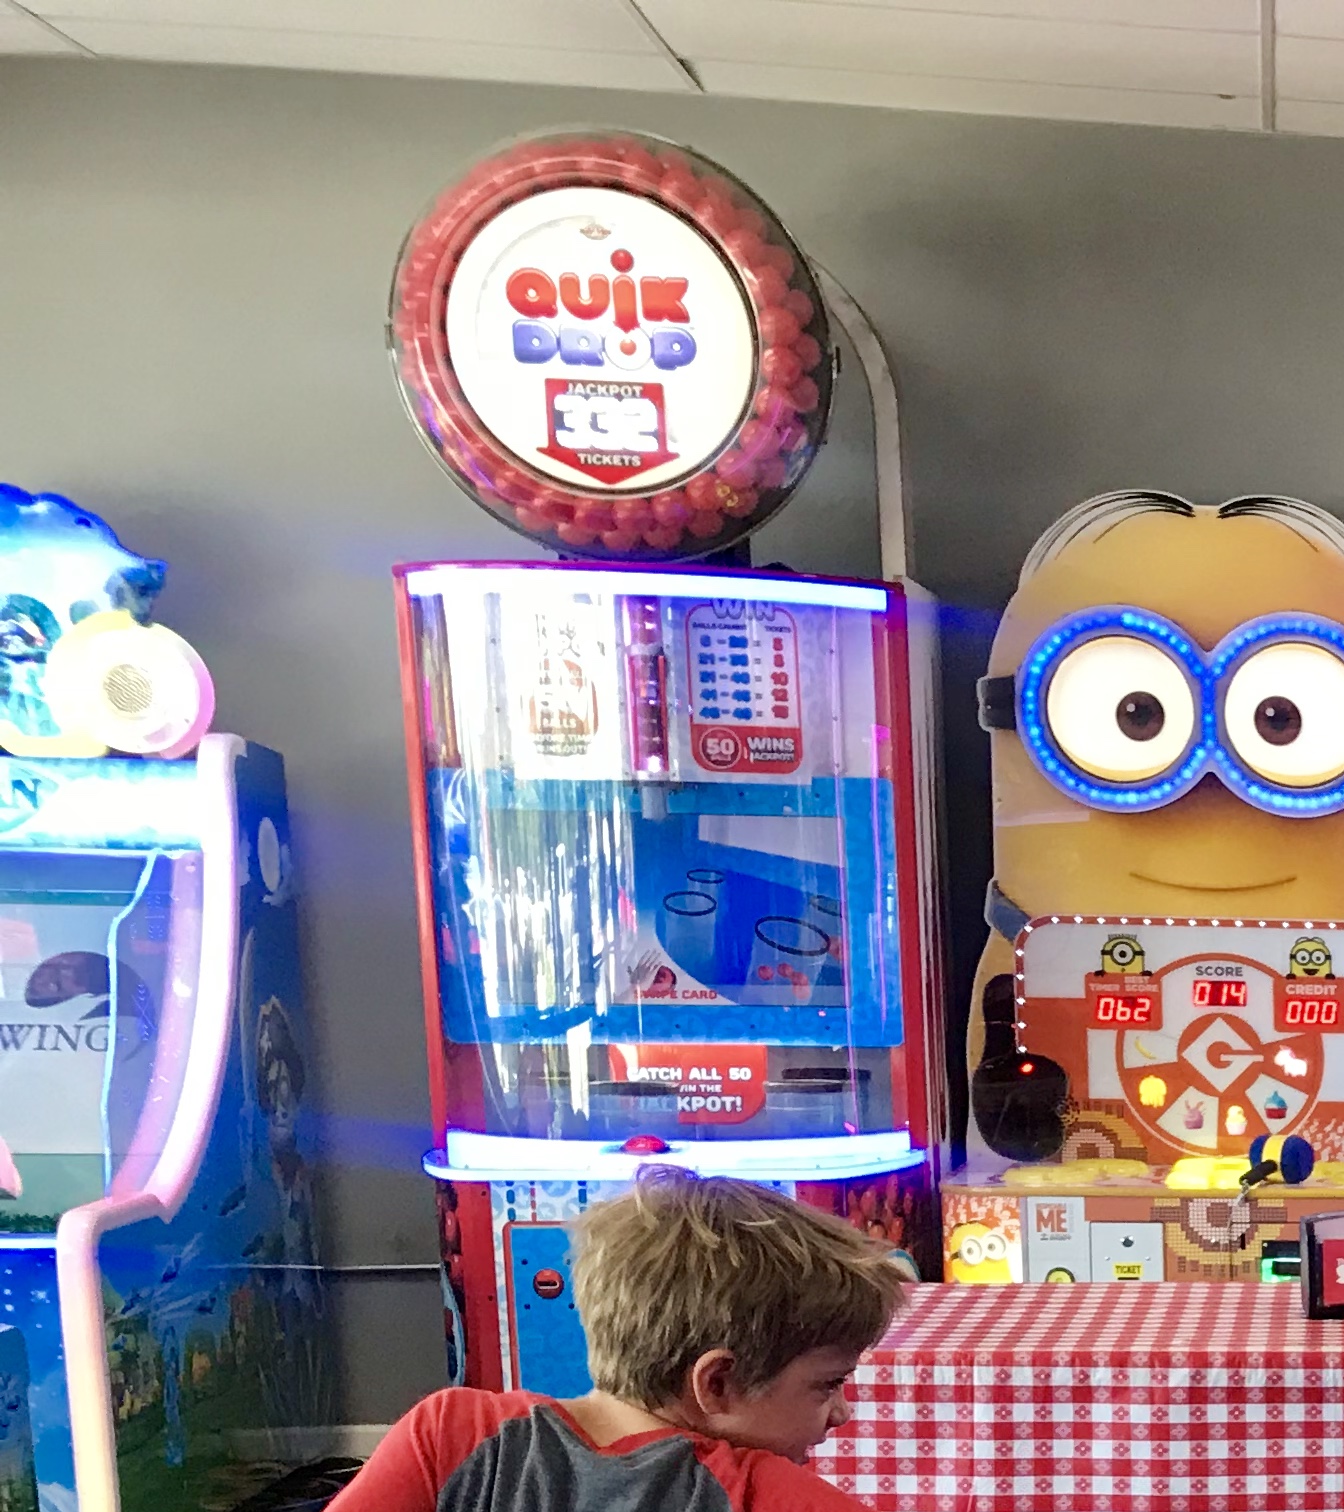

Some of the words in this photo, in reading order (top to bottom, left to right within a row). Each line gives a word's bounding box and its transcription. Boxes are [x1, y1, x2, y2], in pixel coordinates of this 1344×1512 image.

[506, 248, 690, 333] QUIK
[512, 319, 697, 371] DROP
[567, 383, 643, 398] JACKPOT
[577, 452, 642, 467] TICKETS
[706, 738, 735, 755] 50
[747, 736, 795, 752] WINS
[1195, 965, 1244, 977] SCORE
[682, 990, 718, 1000] CARD
[1125, 983, 1160, 993] SCORE
[1194, 982, 1246, 1006] 014
[1285, 984, 1338, 996] CREDIT
[1098, 997, 1151, 1022] 062
[1286, 1000, 1338, 1024] 000
[626, 1067, 682, 1082] CATCH
[689, 1067, 722, 1081] ALL
[729, 1067, 752, 1081] 50
[699, 1084, 722, 1093] THE
[1036, 1208, 1068, 1233] ME
[1114, 1265, 1141, 1274] TICKET
